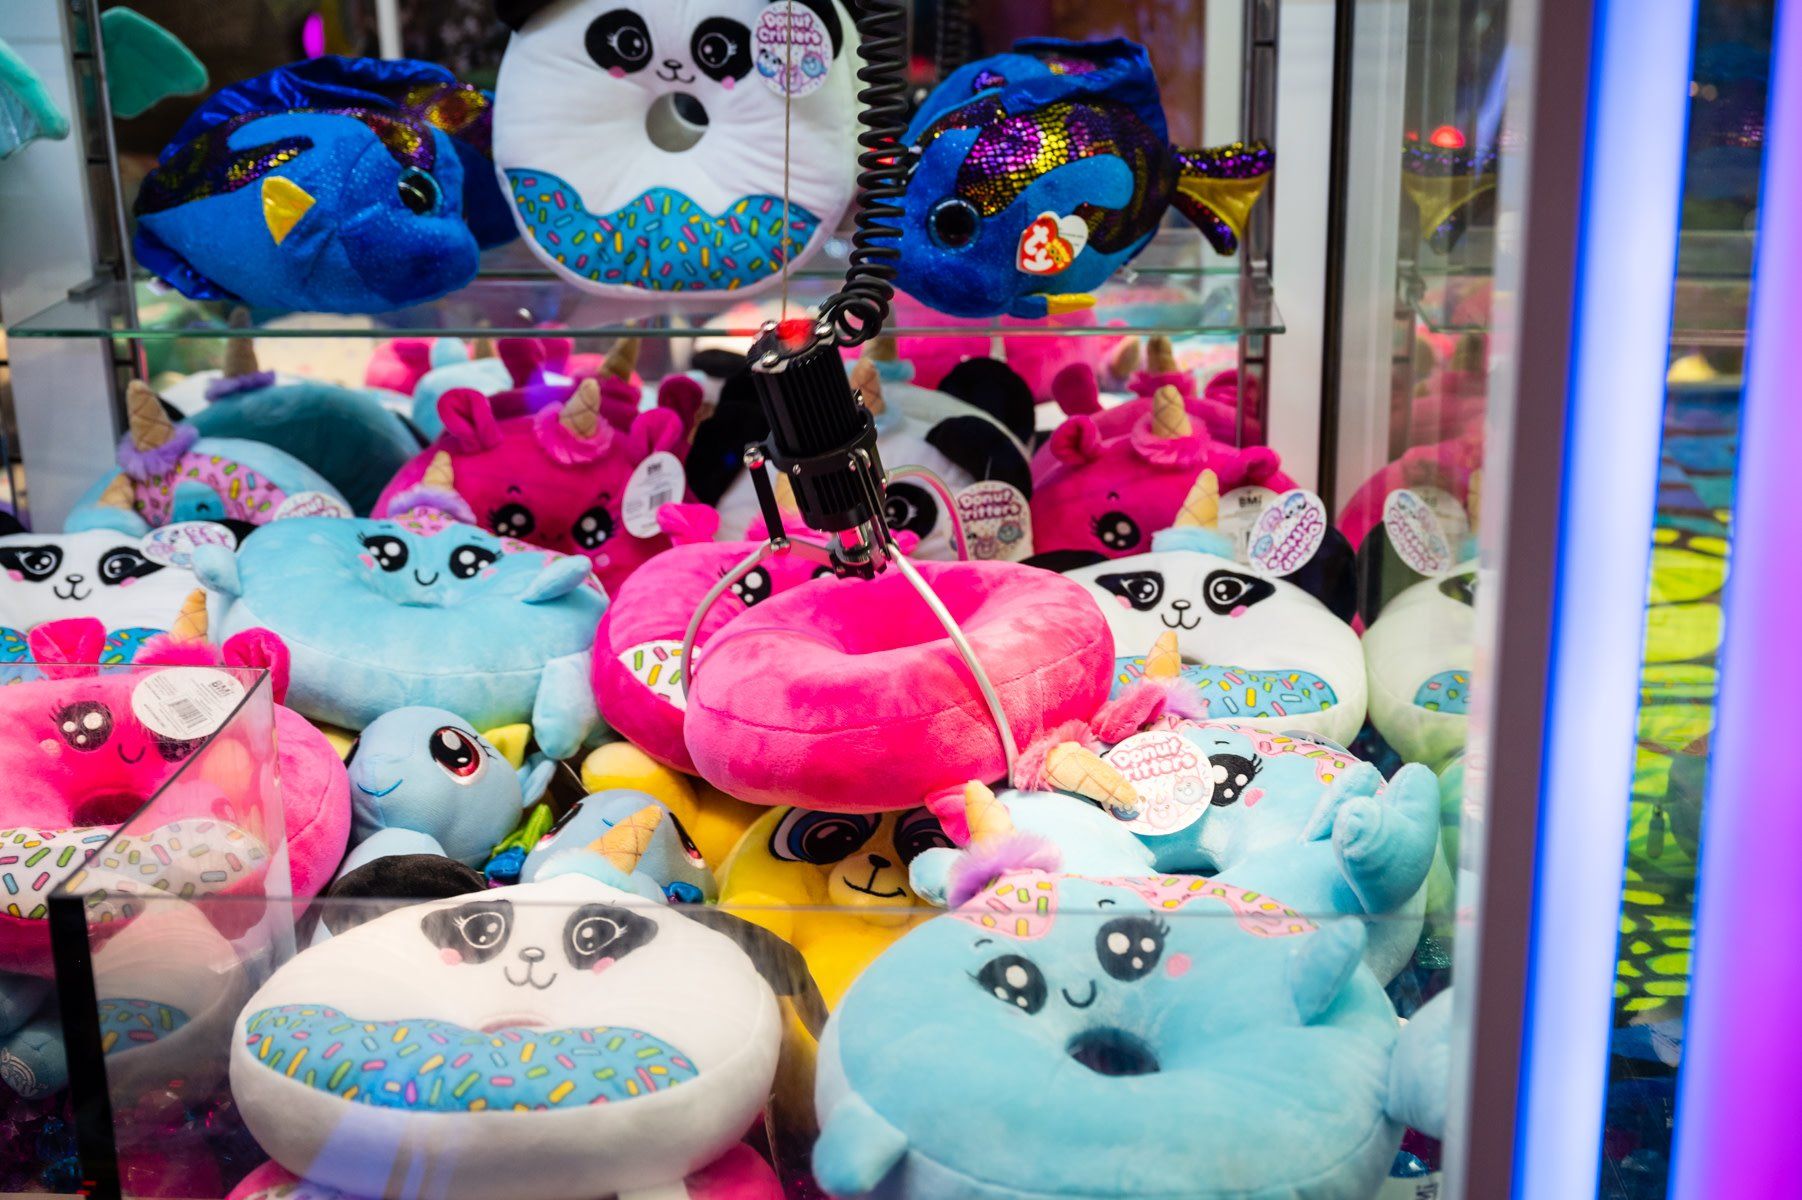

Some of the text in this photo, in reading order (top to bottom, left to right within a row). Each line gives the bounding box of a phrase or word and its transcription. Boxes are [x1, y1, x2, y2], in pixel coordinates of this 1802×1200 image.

[959, 488, 1013, 510] Donut
[961, 501, 1021, 522] ritters
[1110, 736, 1182, 771] Donut
[1123, 752, 1197, 780] ritters
